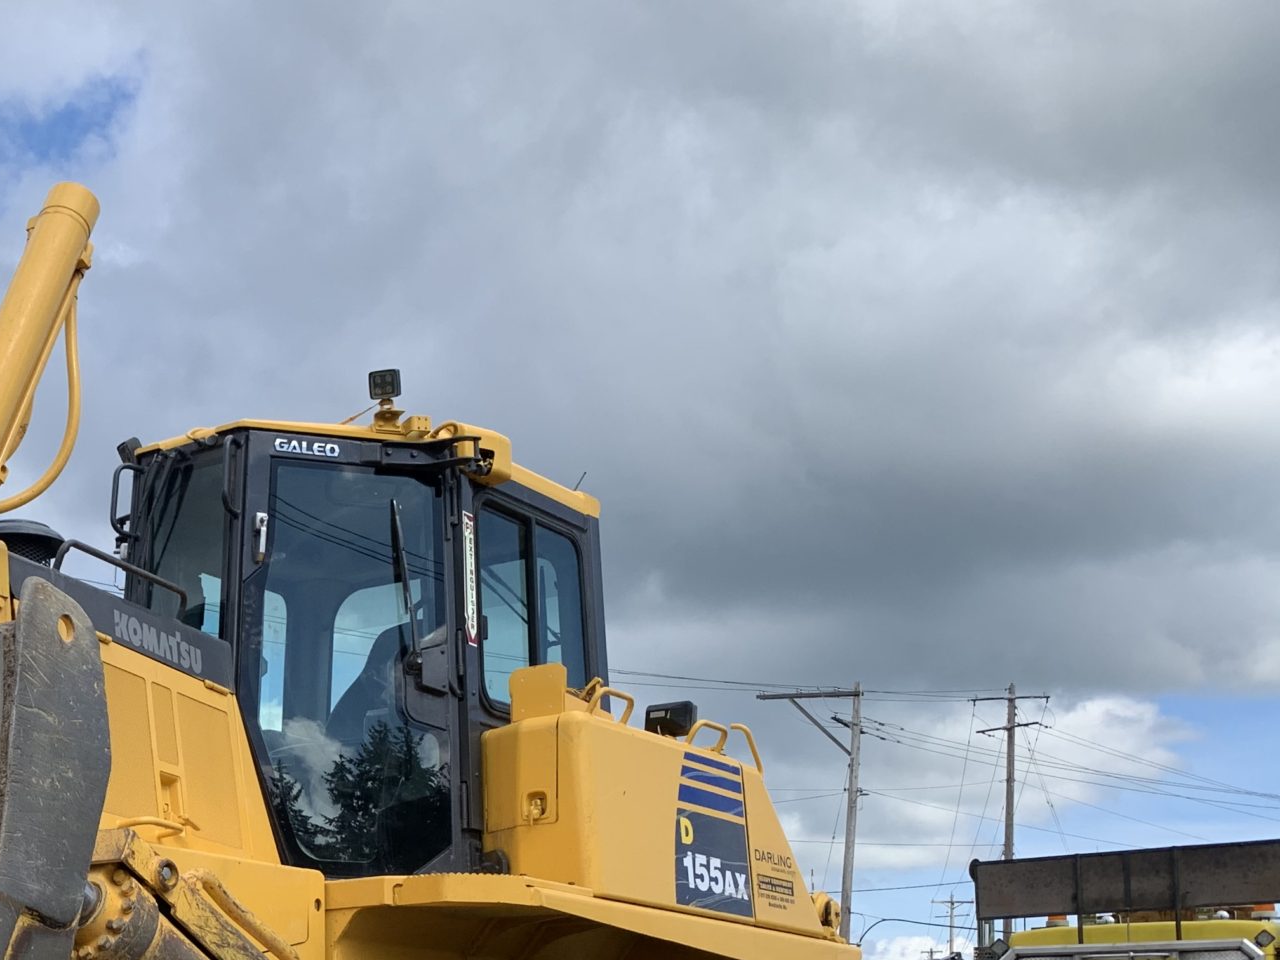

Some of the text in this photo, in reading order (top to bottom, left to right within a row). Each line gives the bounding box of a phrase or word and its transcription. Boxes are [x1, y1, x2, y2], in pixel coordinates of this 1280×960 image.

[274, 438, 340, 457] GALEO
[113, 609, 203, 674] KOMATSU
[680, 816, 694, 845] D
[754, 848, 793, 869] DARLING
[683, 851, 749, 900] 155AX
